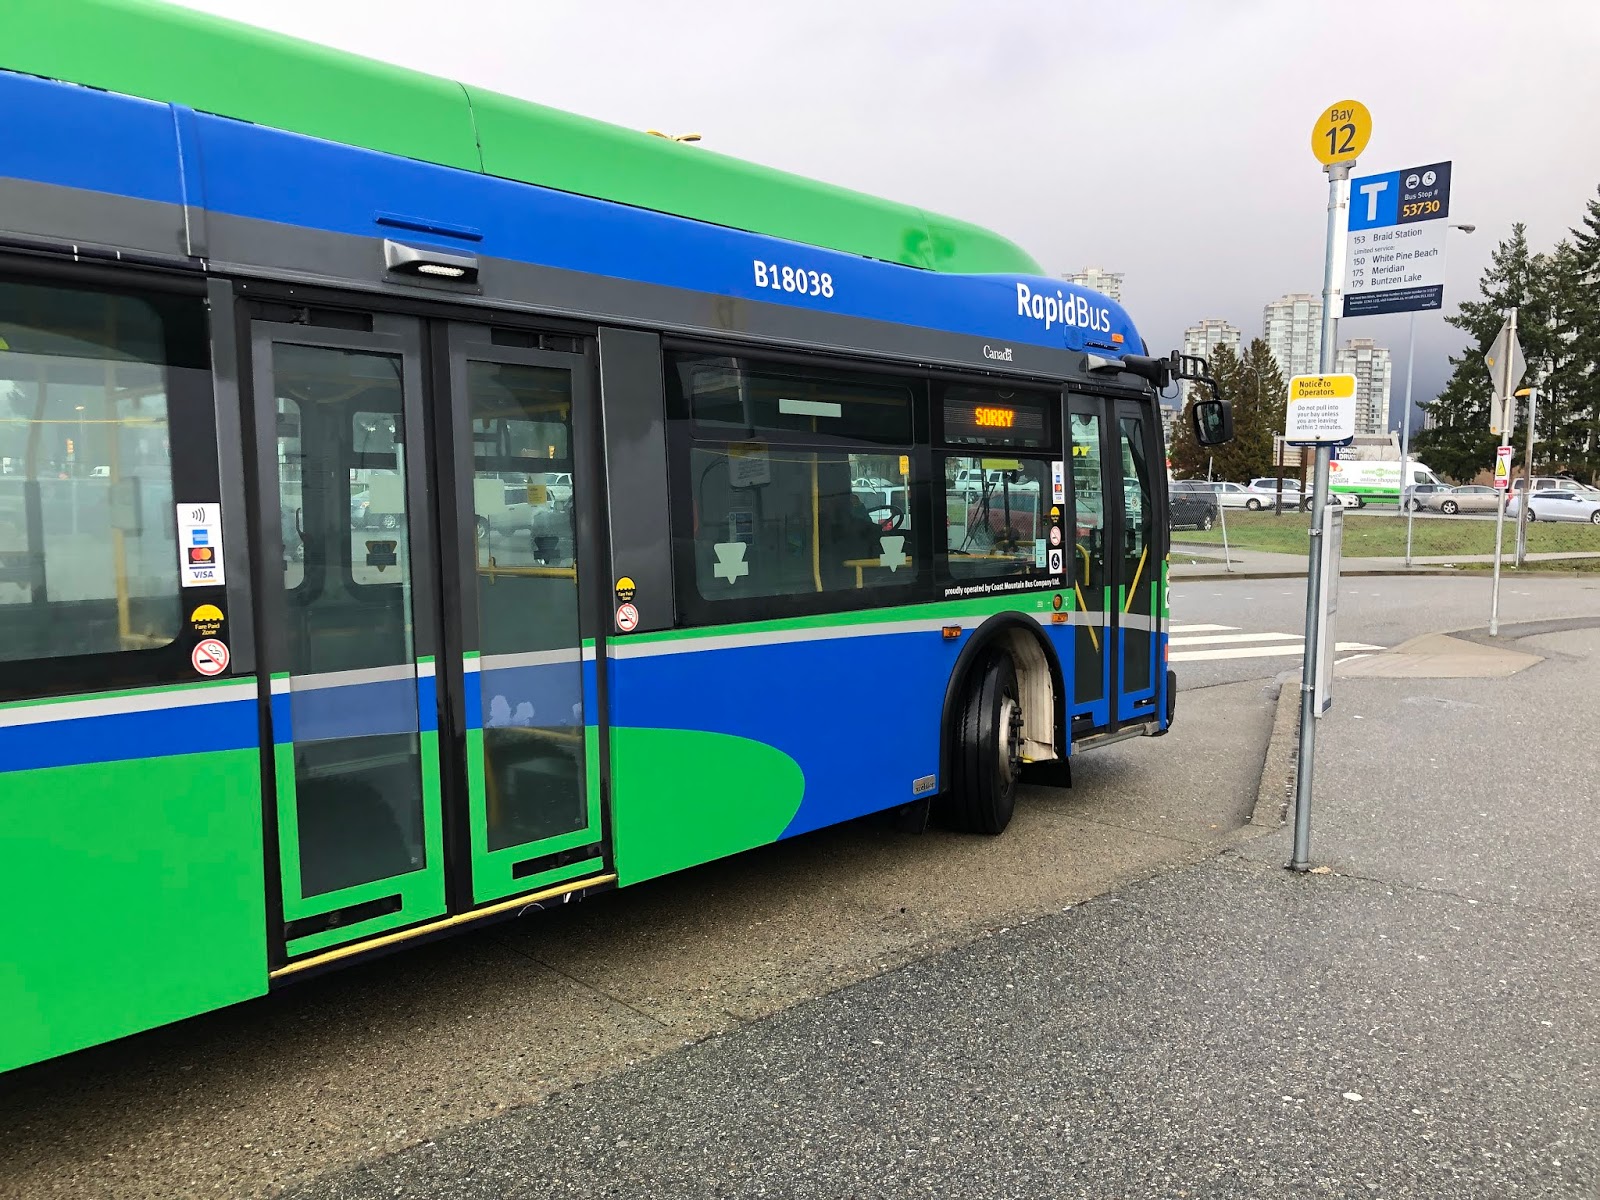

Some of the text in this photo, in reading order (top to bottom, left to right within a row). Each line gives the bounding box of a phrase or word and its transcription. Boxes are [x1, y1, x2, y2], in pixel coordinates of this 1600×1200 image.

[1330, 108, 1354, 122] Bay
[1325, 123, 1356, 155] 12
[1360, 181, 1388, 221] T
[1417, 191, 1432, 199] Stop
[1403, 200, 1440, 217] 53730
[1353, 228, 1423, 244] 153 Braid Station
[1353, 248, 1438, 266] 150 White Pine Beach
[1354, 247, 1373, 255] Limited
[754, 260, 834, 298] B18038
[1352, 264, 1405, 277] 175 Meridian
[1352, 273, 1422, 288] 179 Buntzen Lake
[1017, 282, 1111, 333] RapidBus
[983, 344, 1013, 361] Canada
[1298, 389, 1335, 397] Operators
[975, 407, 1013, 427] SORRY
[944, 577, 1060, 597] proudly operated by Coast Mountain Bus Company Ltd.
